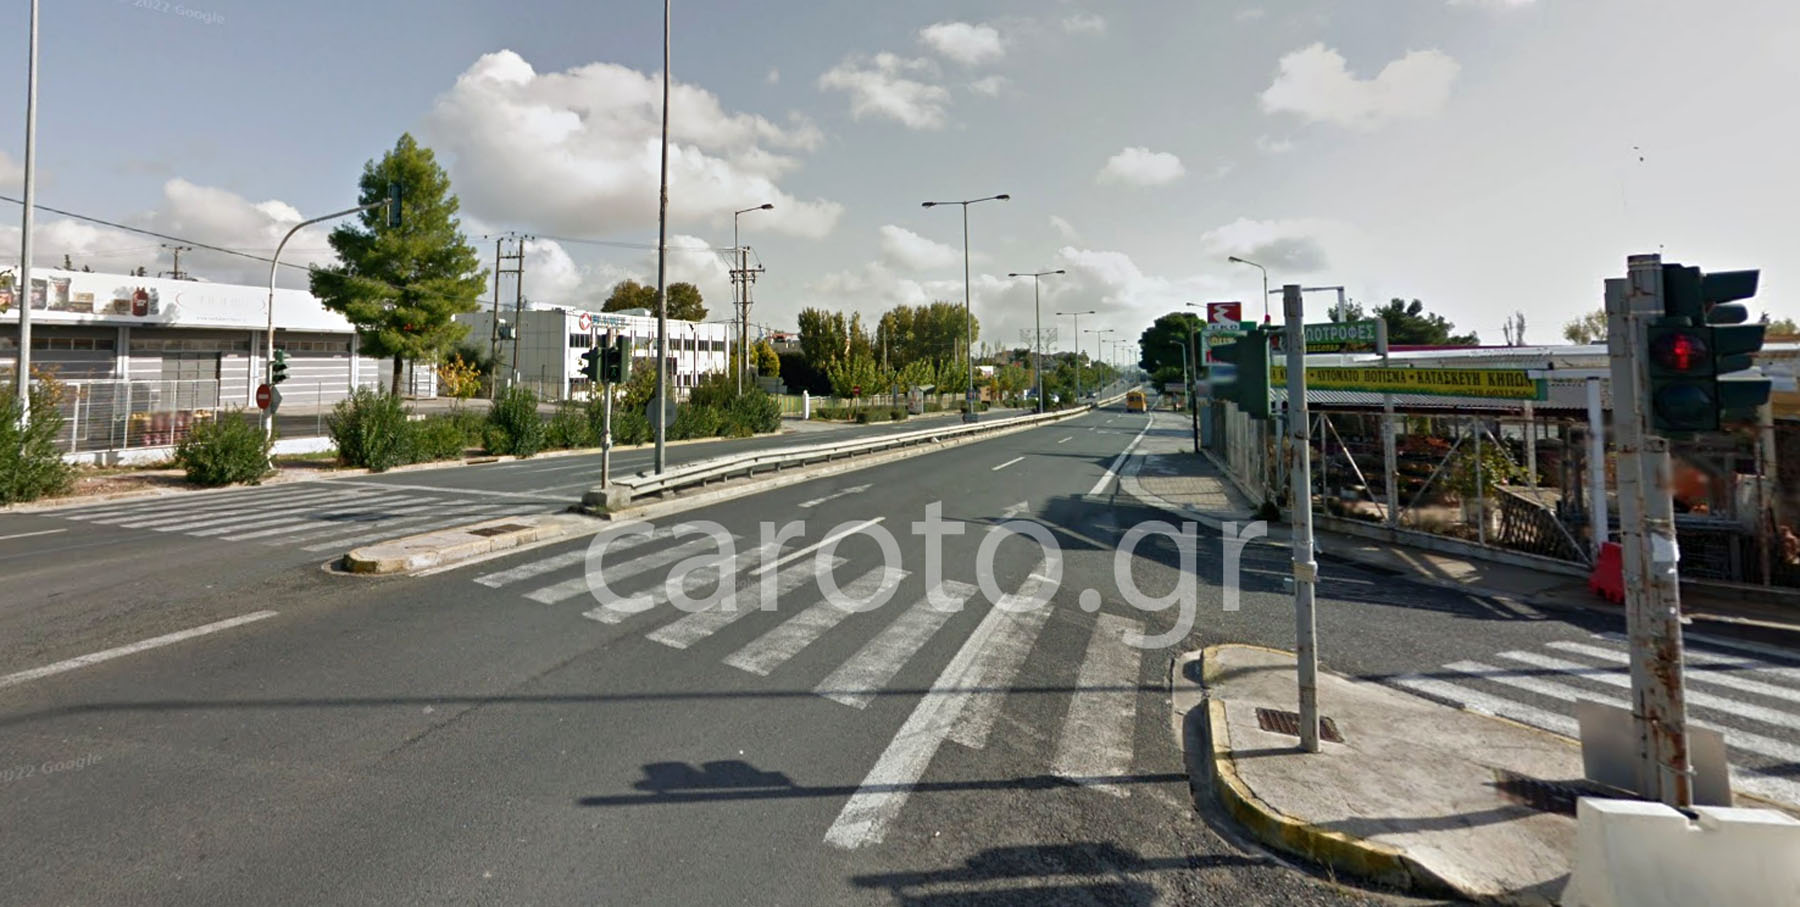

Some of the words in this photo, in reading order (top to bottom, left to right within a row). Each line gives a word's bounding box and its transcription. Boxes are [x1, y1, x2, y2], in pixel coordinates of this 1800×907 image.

[1306, 324, 1374, 341] ΩΟΤΡΟΦΕΣ
[1416, 371, 1480, 386] ΚΑΤΑΣΚΕΥΗ
[1487, 372, 1533, 388] ΚΗΠΩΝ
